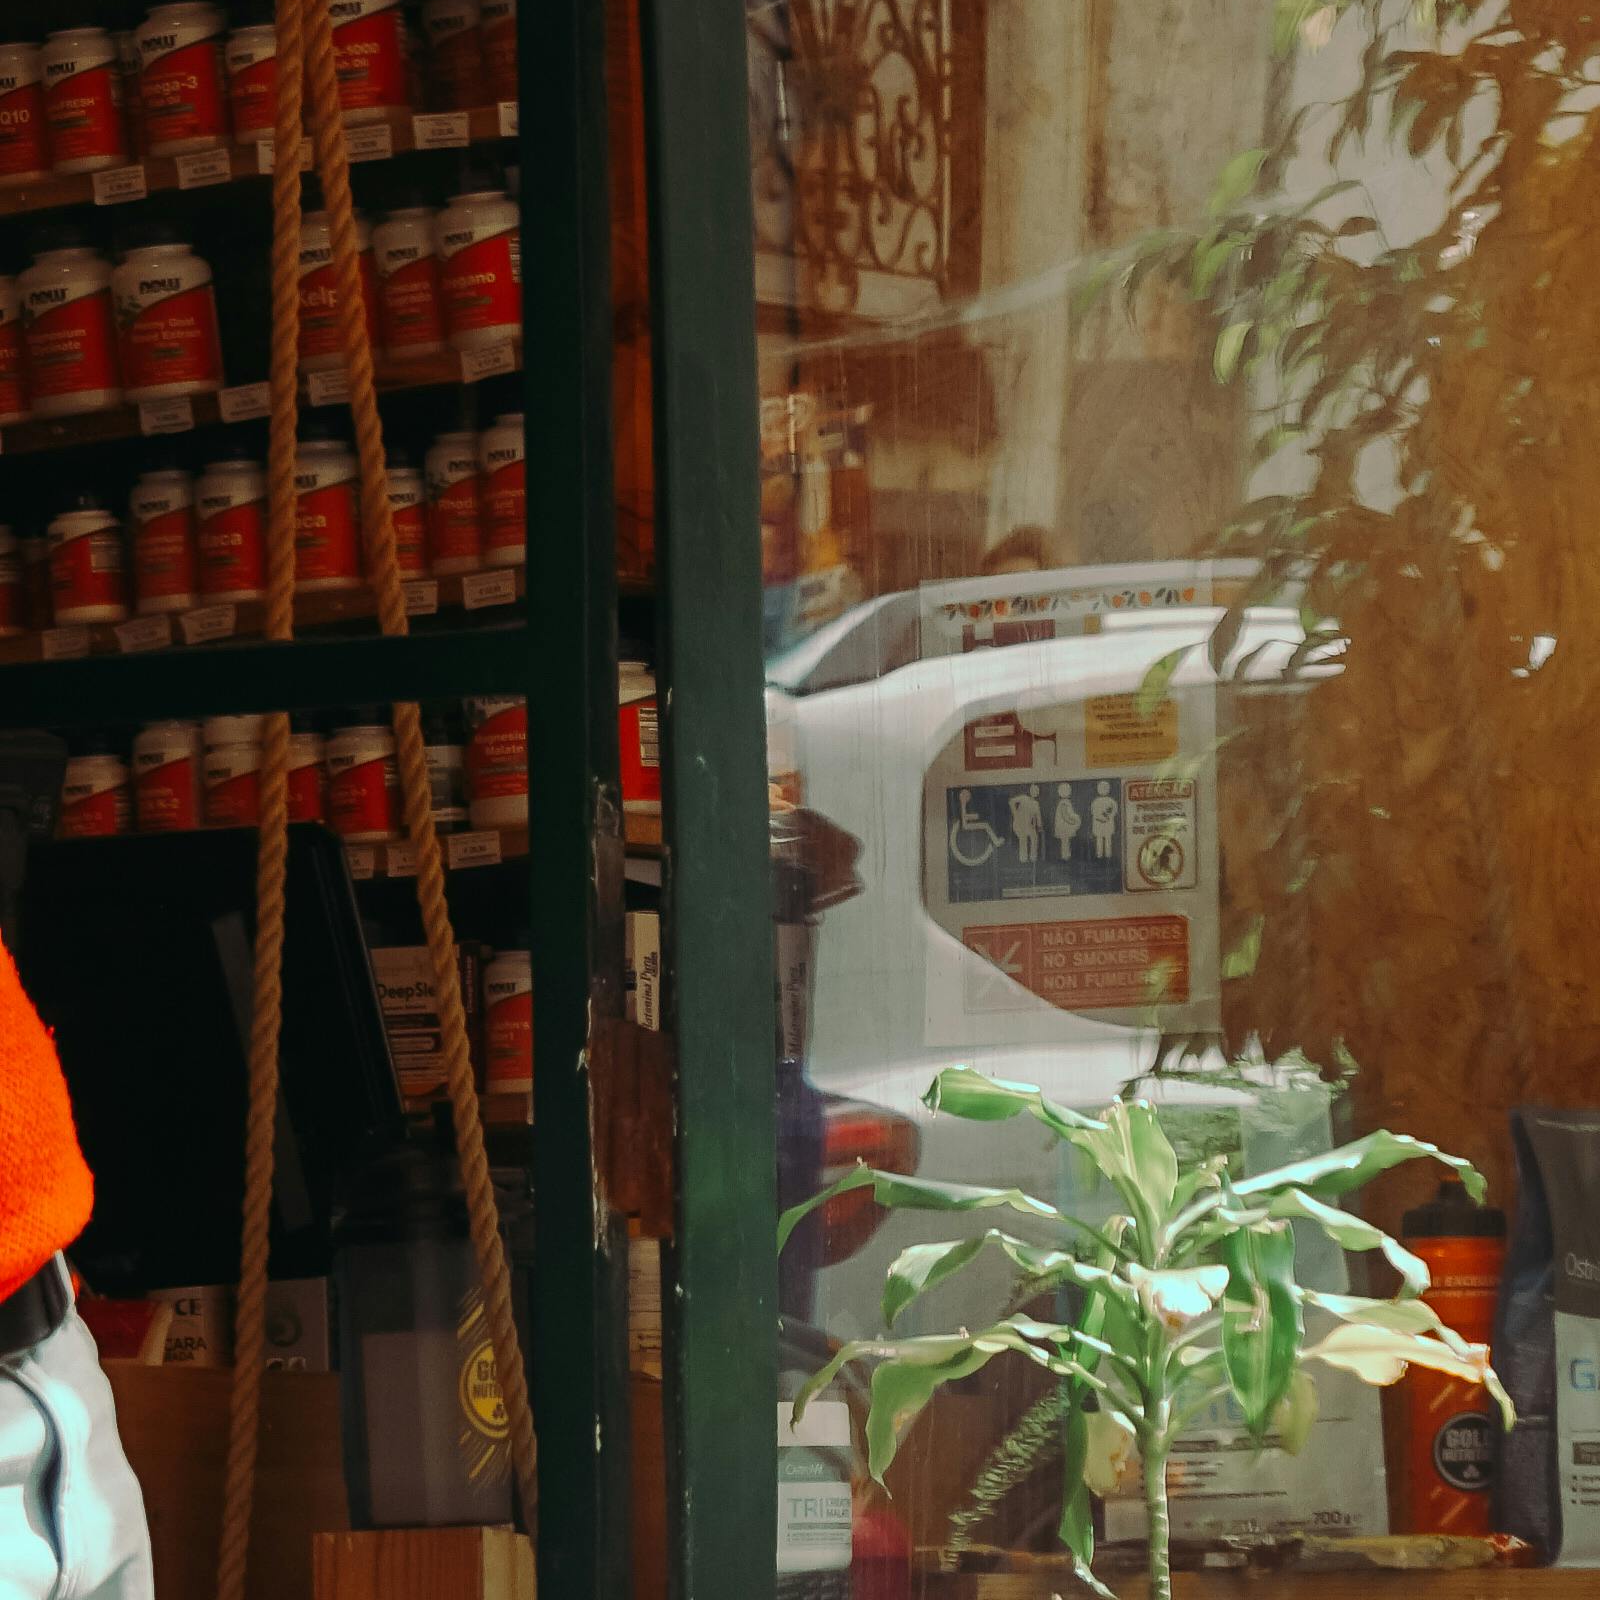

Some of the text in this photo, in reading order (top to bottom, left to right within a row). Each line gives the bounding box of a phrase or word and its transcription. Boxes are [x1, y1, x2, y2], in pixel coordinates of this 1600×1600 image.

[1042, 925, 1185, 946] NÃO FUMADORES
[1042, 949, 1150, 969] NO SMOKERS
[377, 982, 437, 1002] DeepSle
[1042, 974, 1078, 991] NON
